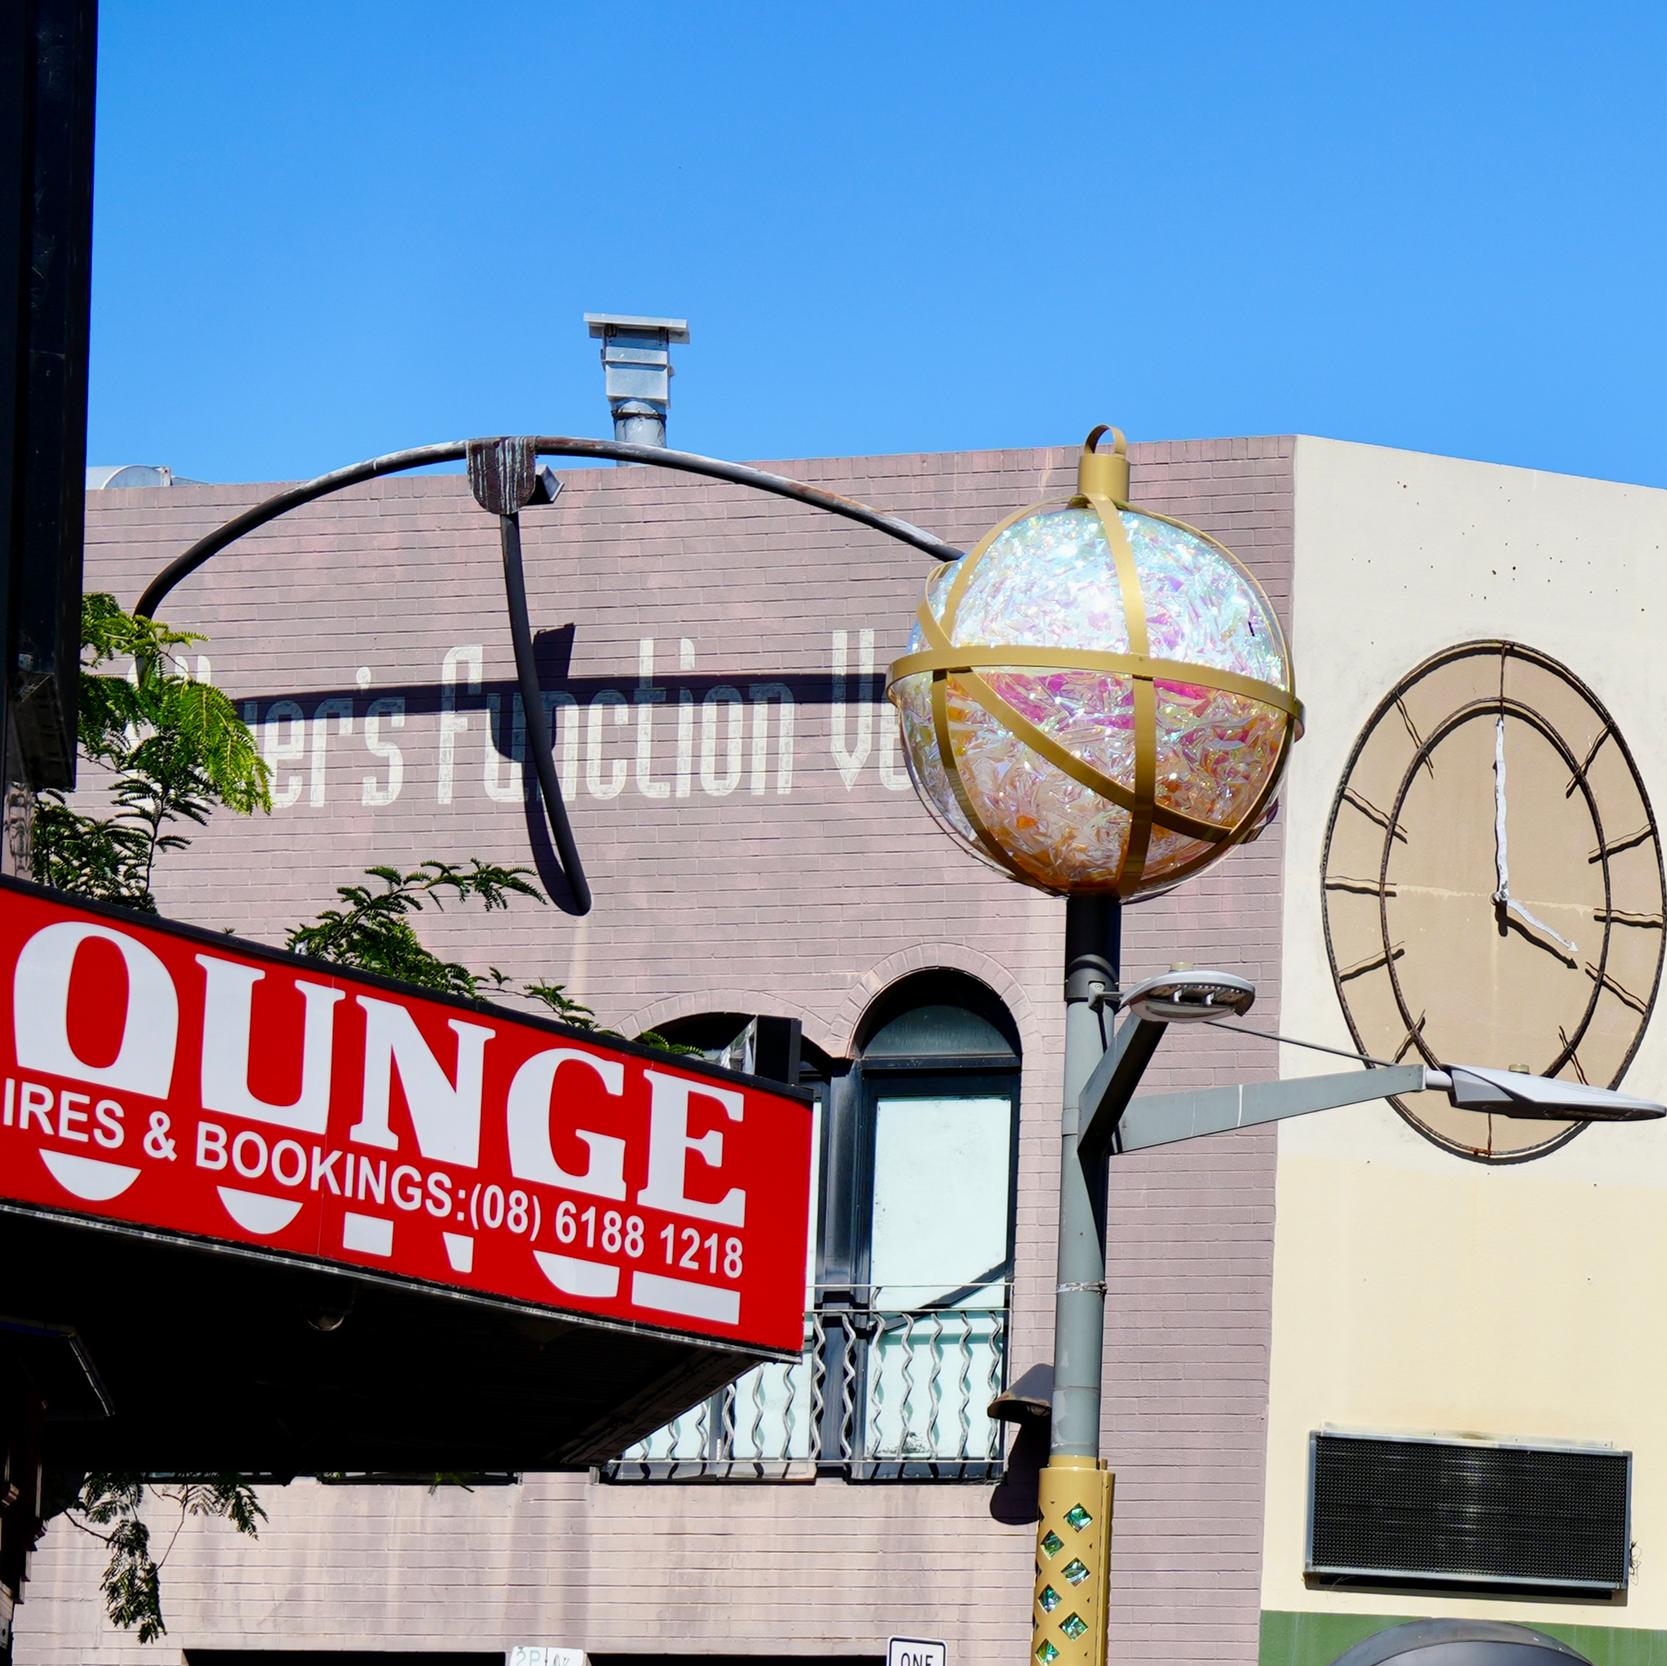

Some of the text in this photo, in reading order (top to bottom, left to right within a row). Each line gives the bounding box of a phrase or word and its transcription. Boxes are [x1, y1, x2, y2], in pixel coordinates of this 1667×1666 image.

[437, 637, 796, 804] Function
[143, 1111, 178, 1162] &
[555, 1200, 645, 1258] 6188
[661, 1223, 744, 1280] 1218
